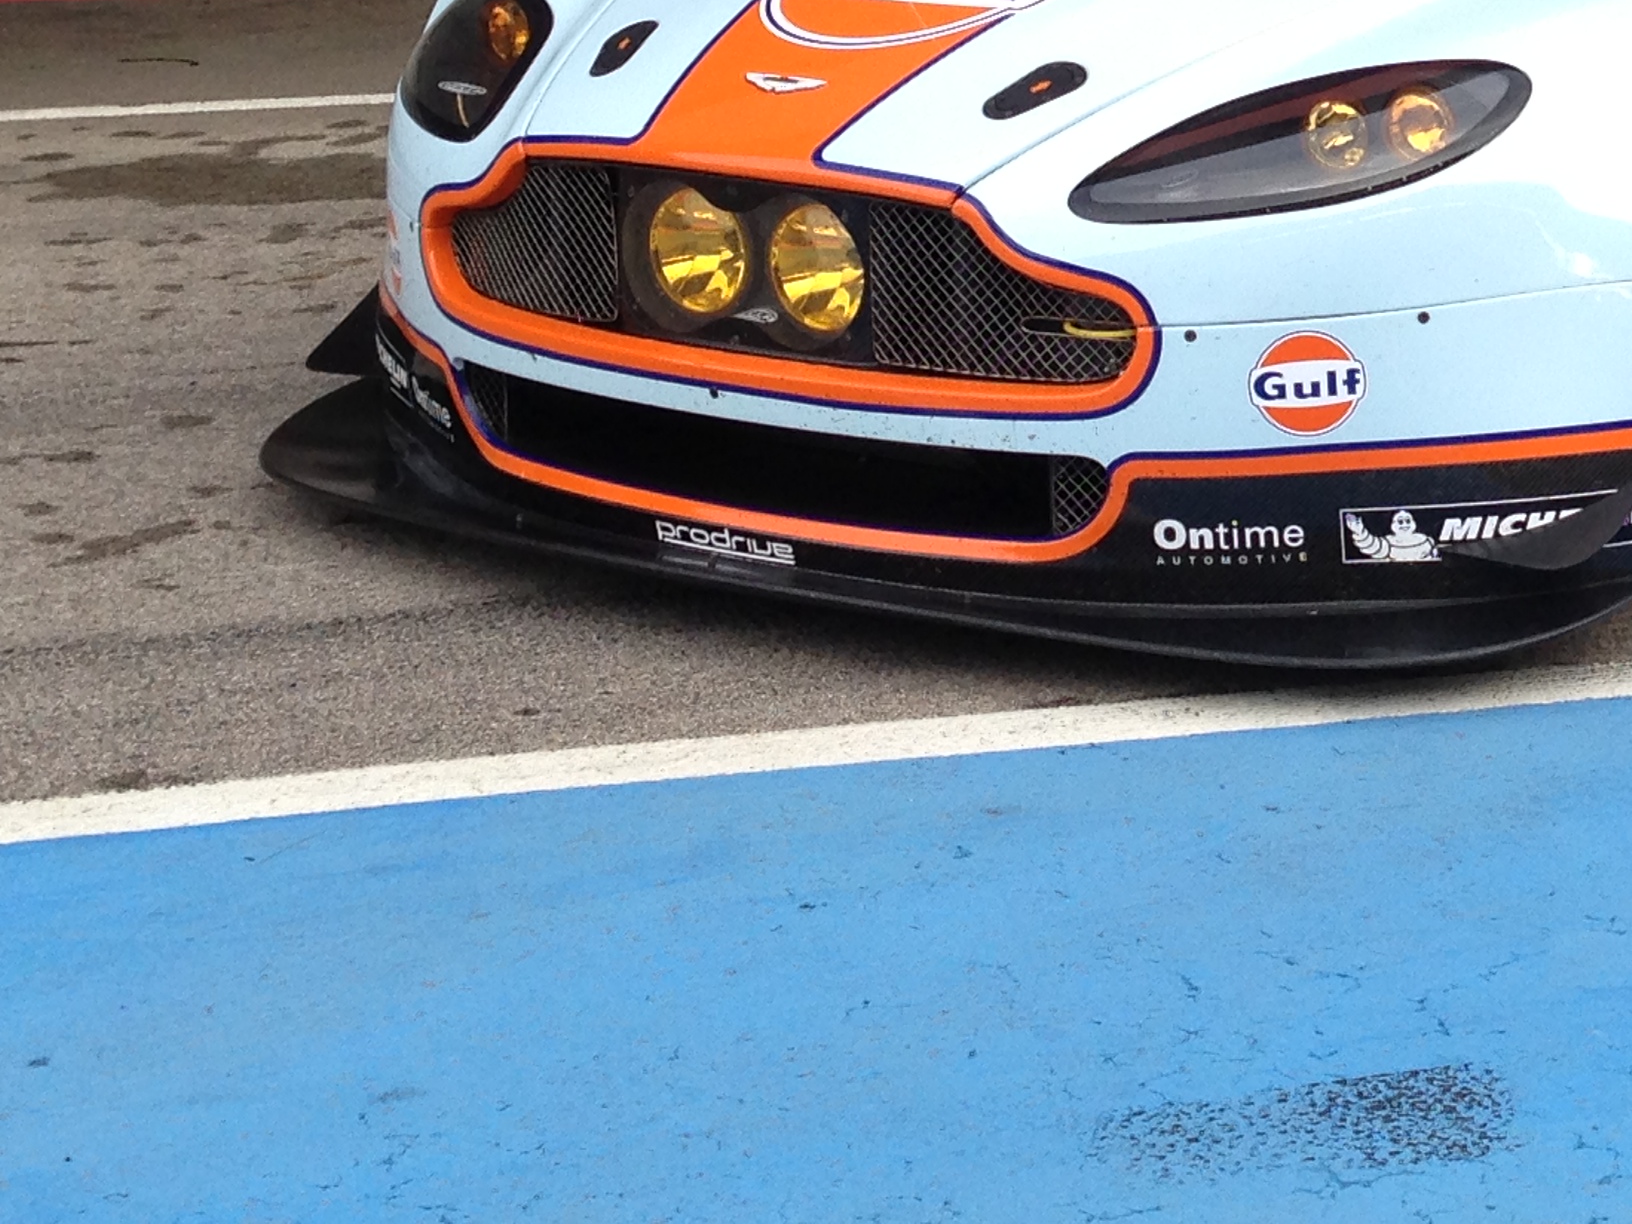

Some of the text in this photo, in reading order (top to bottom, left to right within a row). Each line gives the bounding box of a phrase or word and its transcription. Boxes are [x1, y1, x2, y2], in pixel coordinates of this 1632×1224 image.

[1253, 368, 1361, 401] Gulf
[655, 520, 795, 559] prodrive
[1153, 519, 1305, 550] Ontime
[1156, 552, 1307, 566] AUTOMOTIVE
